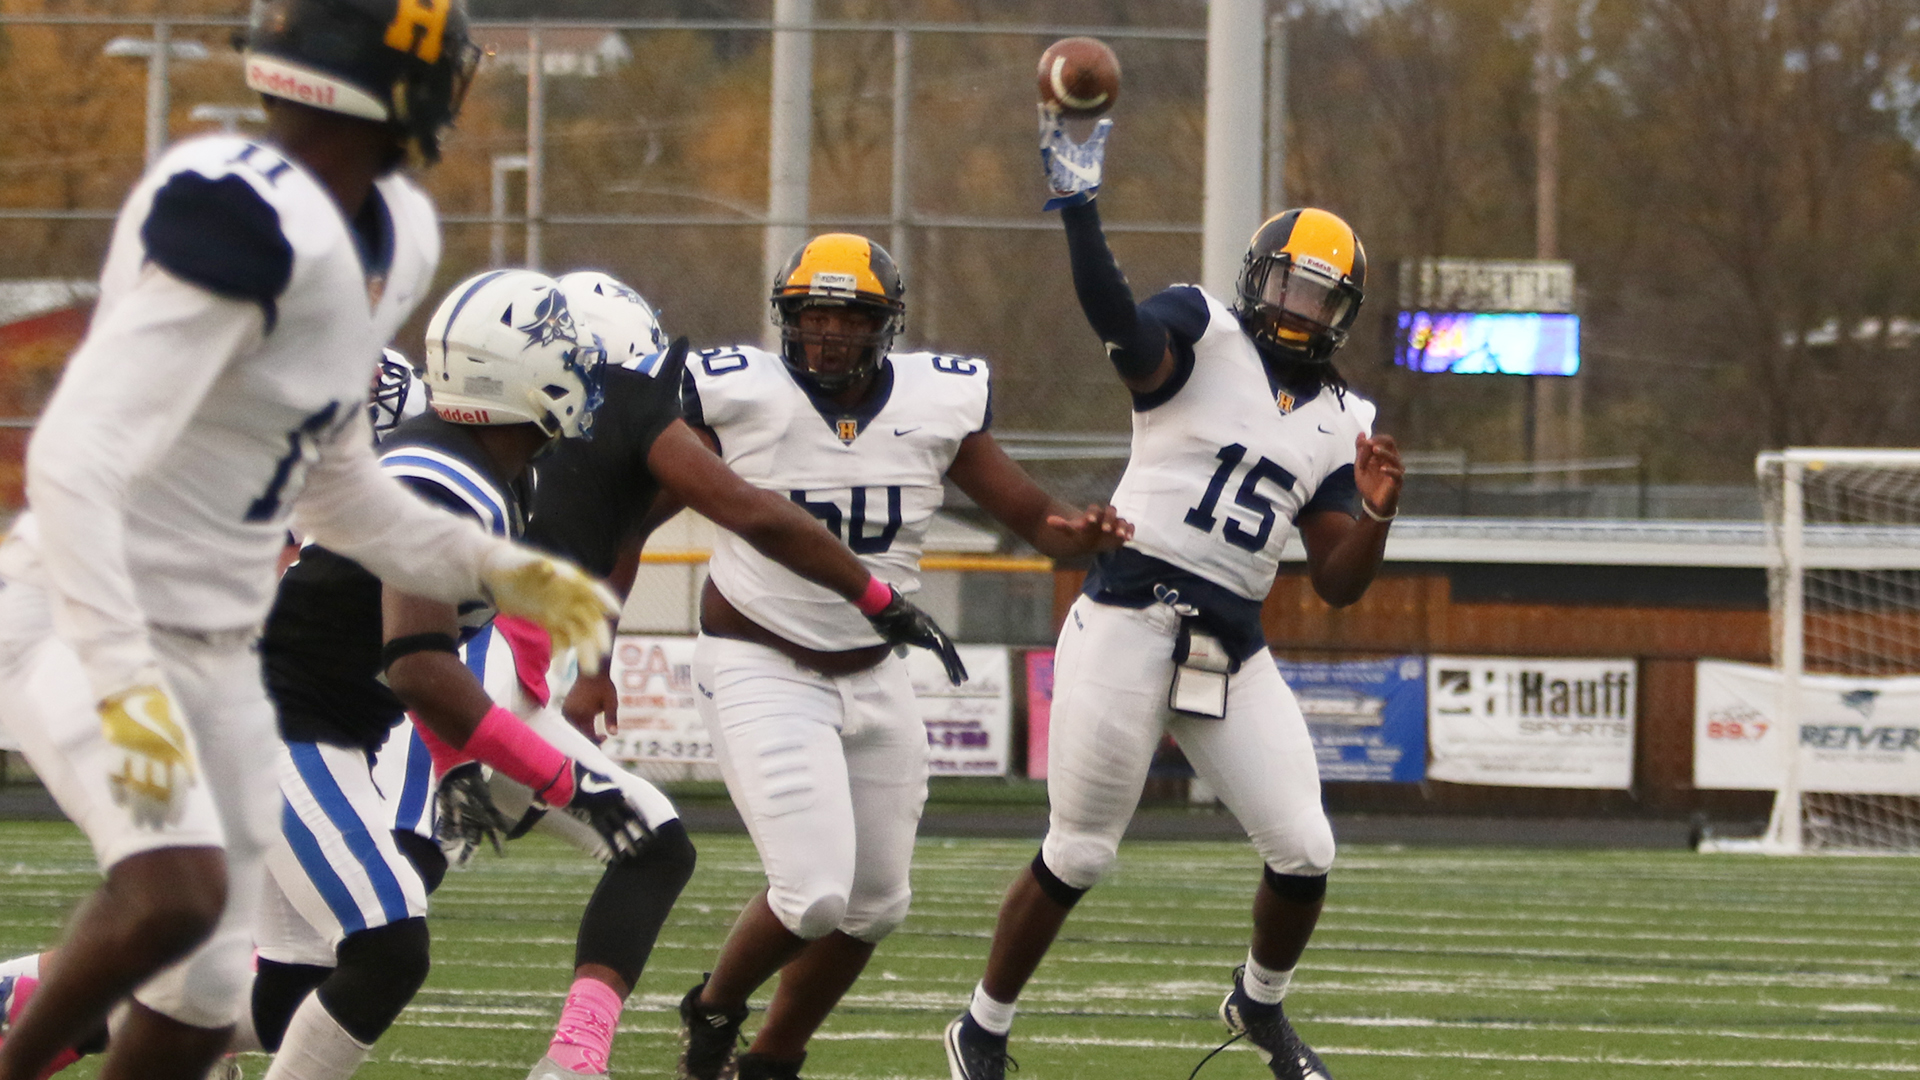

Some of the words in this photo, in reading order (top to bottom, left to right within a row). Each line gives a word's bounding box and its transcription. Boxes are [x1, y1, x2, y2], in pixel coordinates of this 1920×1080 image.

[384, 0, 450, 64] H
[836, 420, 858, 441] H
[1183, 442, 1297, 553] 15
[1519, 670, 1629, 719] Hauff
